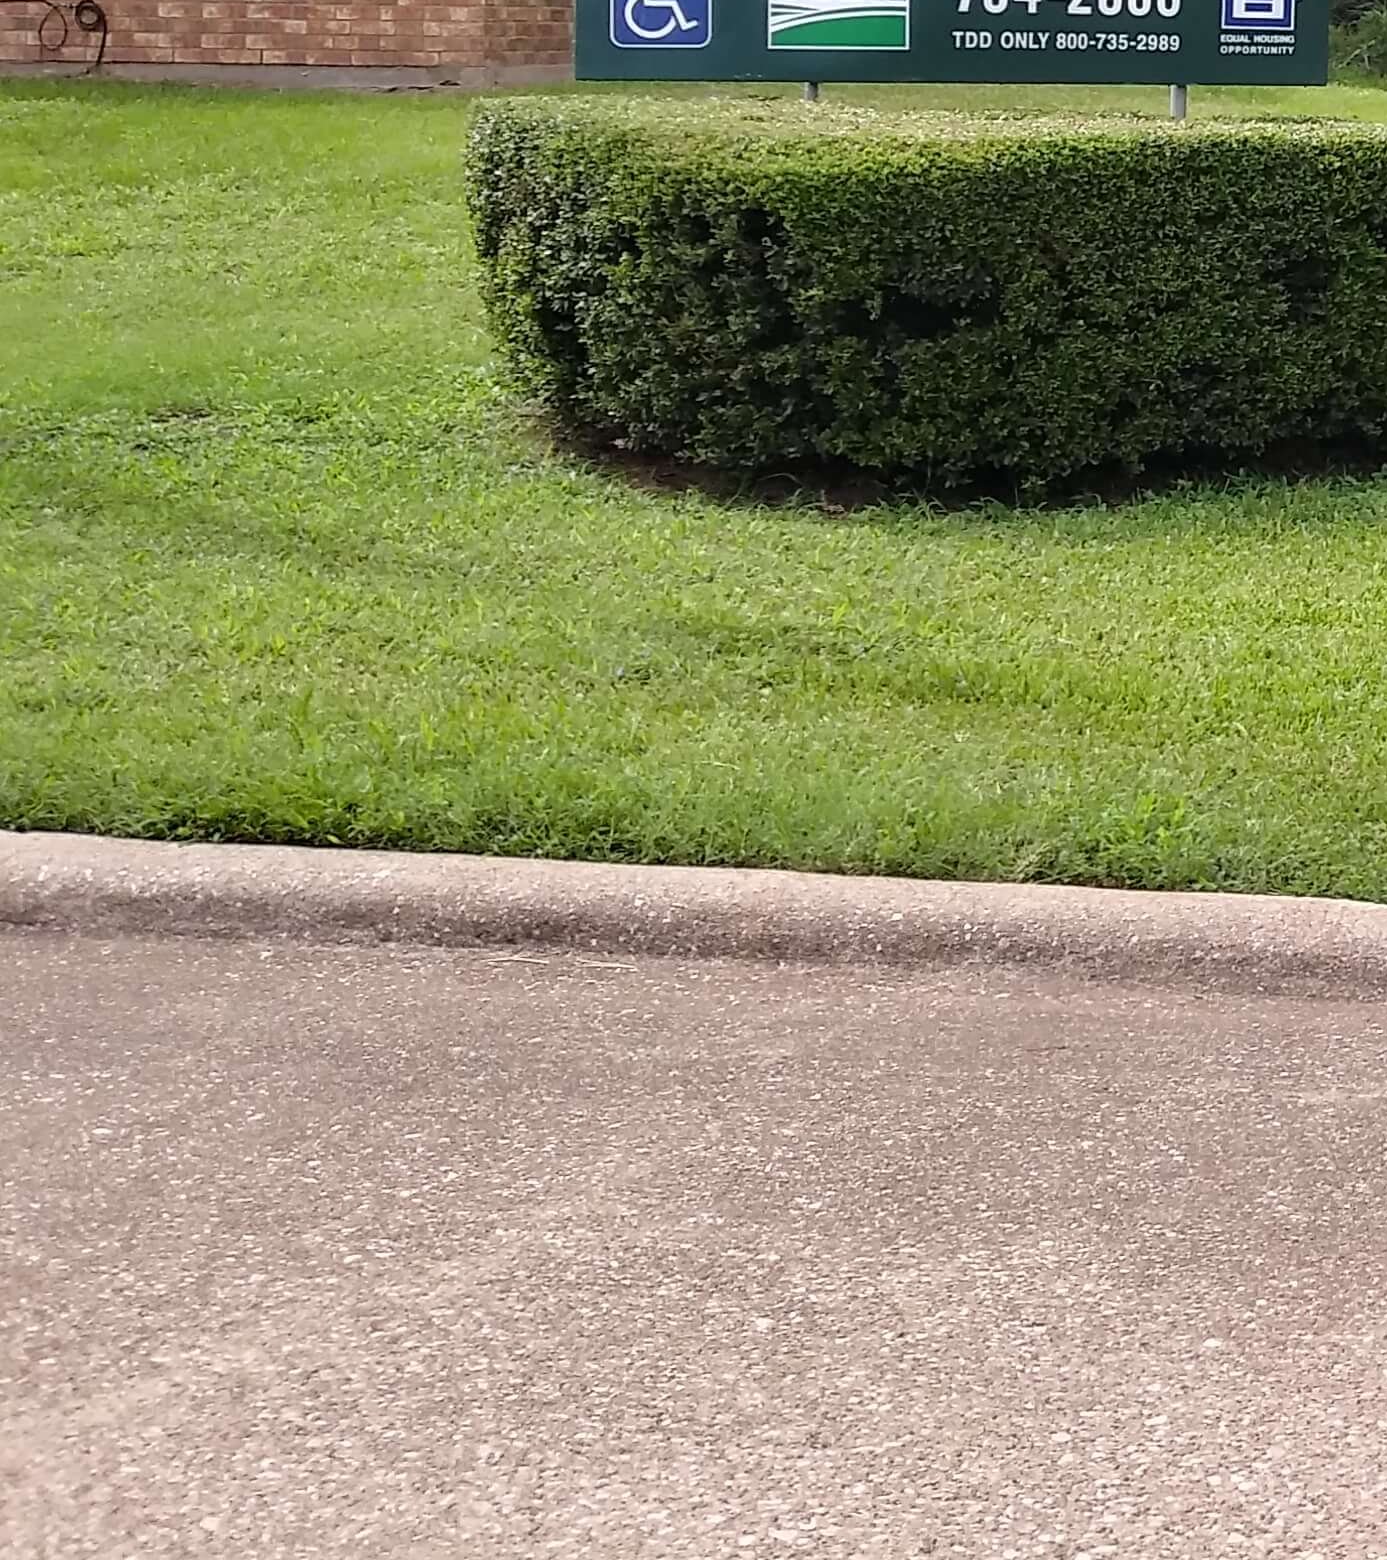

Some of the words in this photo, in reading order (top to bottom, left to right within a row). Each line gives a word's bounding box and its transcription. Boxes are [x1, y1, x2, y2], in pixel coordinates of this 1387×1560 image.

[952, 31, 993, 49] TDD
[1000, 32, 1050, 50] ONLY
[1055, 33, 1181, 52] 800-735-2989
[1220, 34, 1251, 43] EQUAL
[1253, 34, 1295, 44] HOUSING
[1220, 45, 1295, 55] OPPORTUNITY
